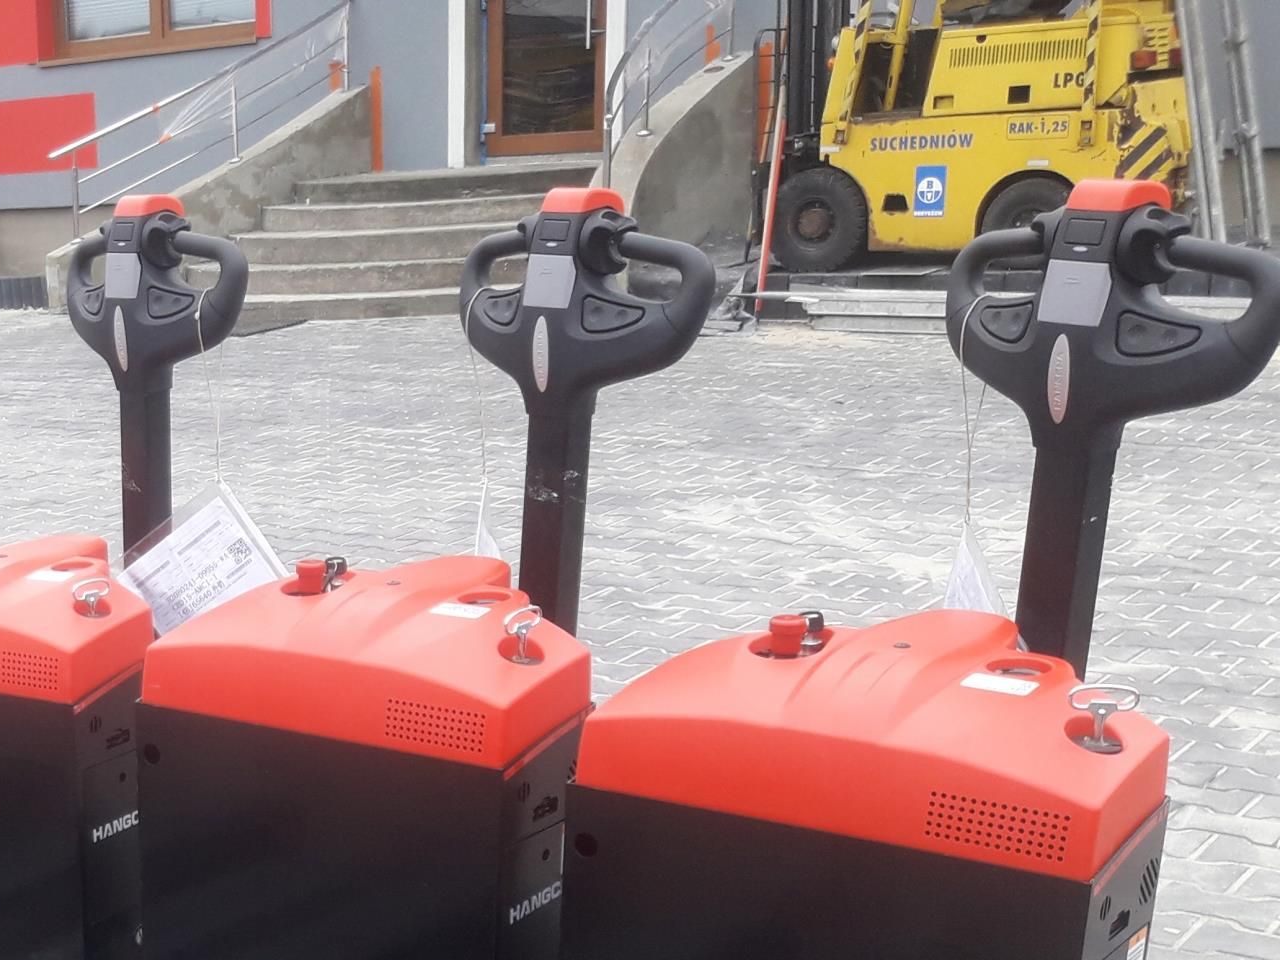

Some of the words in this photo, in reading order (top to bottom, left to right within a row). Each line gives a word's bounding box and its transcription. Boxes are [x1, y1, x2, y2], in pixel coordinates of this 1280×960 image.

[1053, 72, 1085, 88] LPG
[870, 129, 974, 152] SUCHEDNIÓW
[92, 810, 139, 843] HANGC
[509, 881, 562, 925] HANGC
